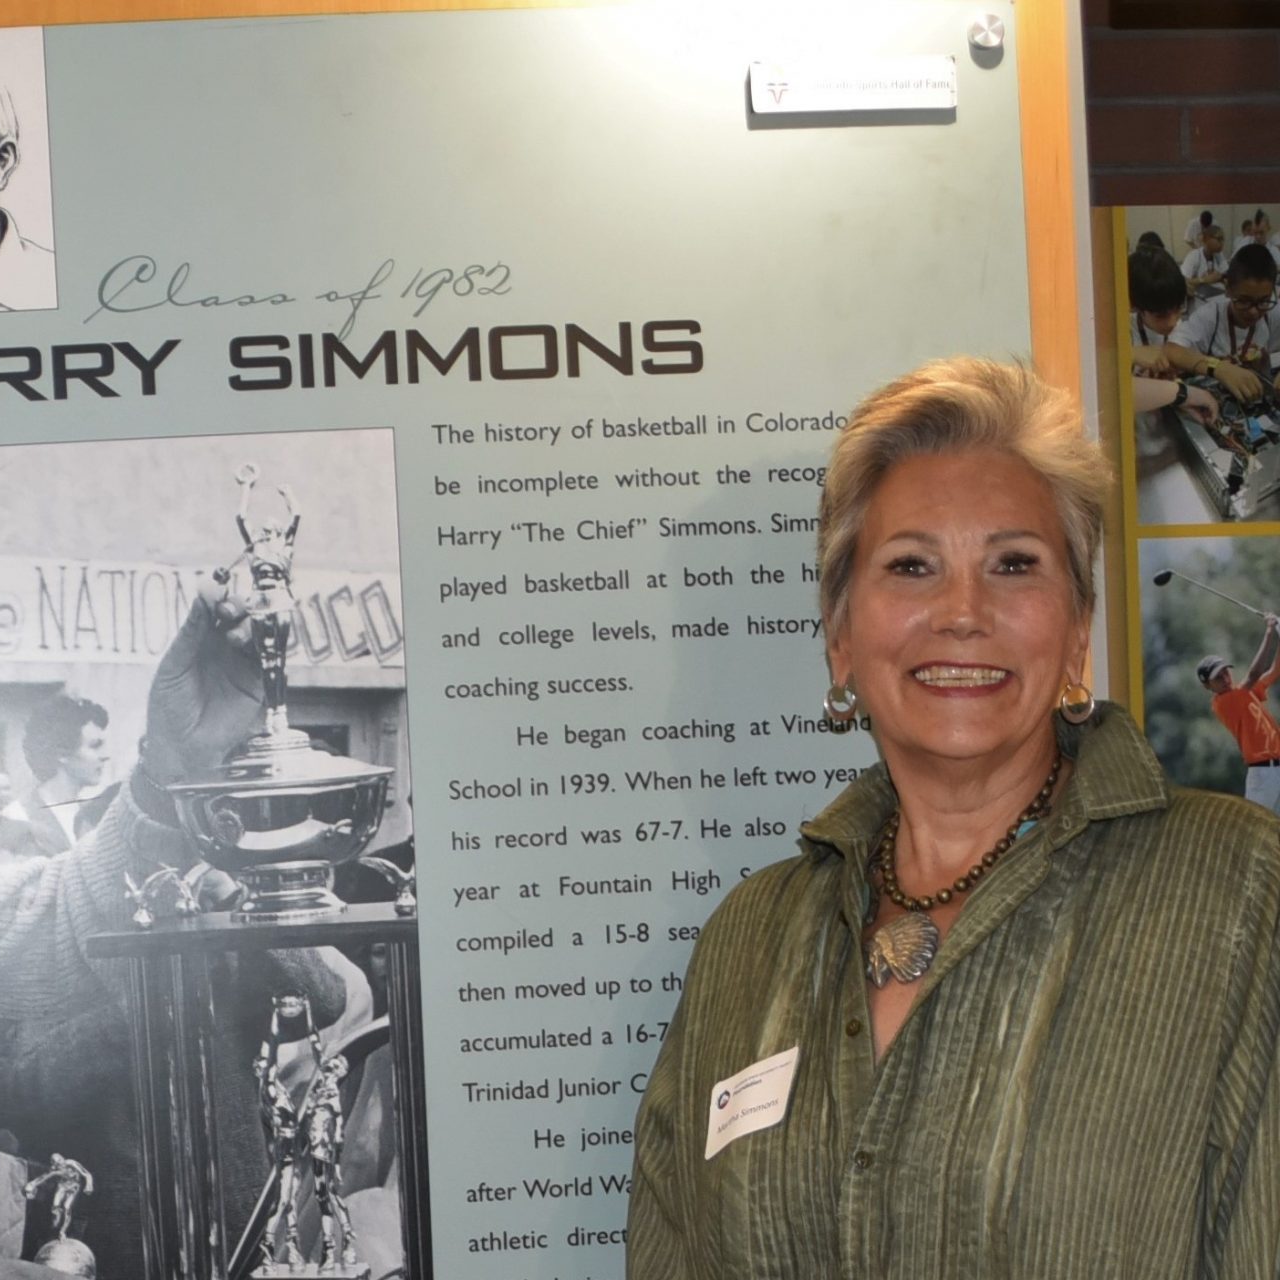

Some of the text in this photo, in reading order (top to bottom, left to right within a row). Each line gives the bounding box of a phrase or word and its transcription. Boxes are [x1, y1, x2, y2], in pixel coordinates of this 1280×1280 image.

[84, 254, 513, 340] Class of 1982
[228, 319, 705, 391] SIMMONS
[430, 410, 849, 447] The history of basketball in Colorado
[434, 463, 752, 498] be incomplete without the
[437, 516, 762, 551] Harry "The Chief" Simmons.
[441, 614, 824, 650] and college levels, made history
[444, 676, 634, 702] coaching success.
[516, 725, 549, 747] He
[564, 723, 626, 750] began
[641, 718, 736, 744] coaching
[749, 719, 771, 737] at
[448, 765, 817, 801] School in 1939. When he left two
[451, 816, 787, 851] his record was 67-7. He also
[455, 922, 650, 956] compiled a 15-8
[460, 1025, 614, 1053] accumulated a
[461, 1077, 622, 1104] Trinidad Junior
[533, 1128, 566, 1150] He
[466, 1175, 593, 1203] after World
[468, 1230, 549, 1253] athletic
